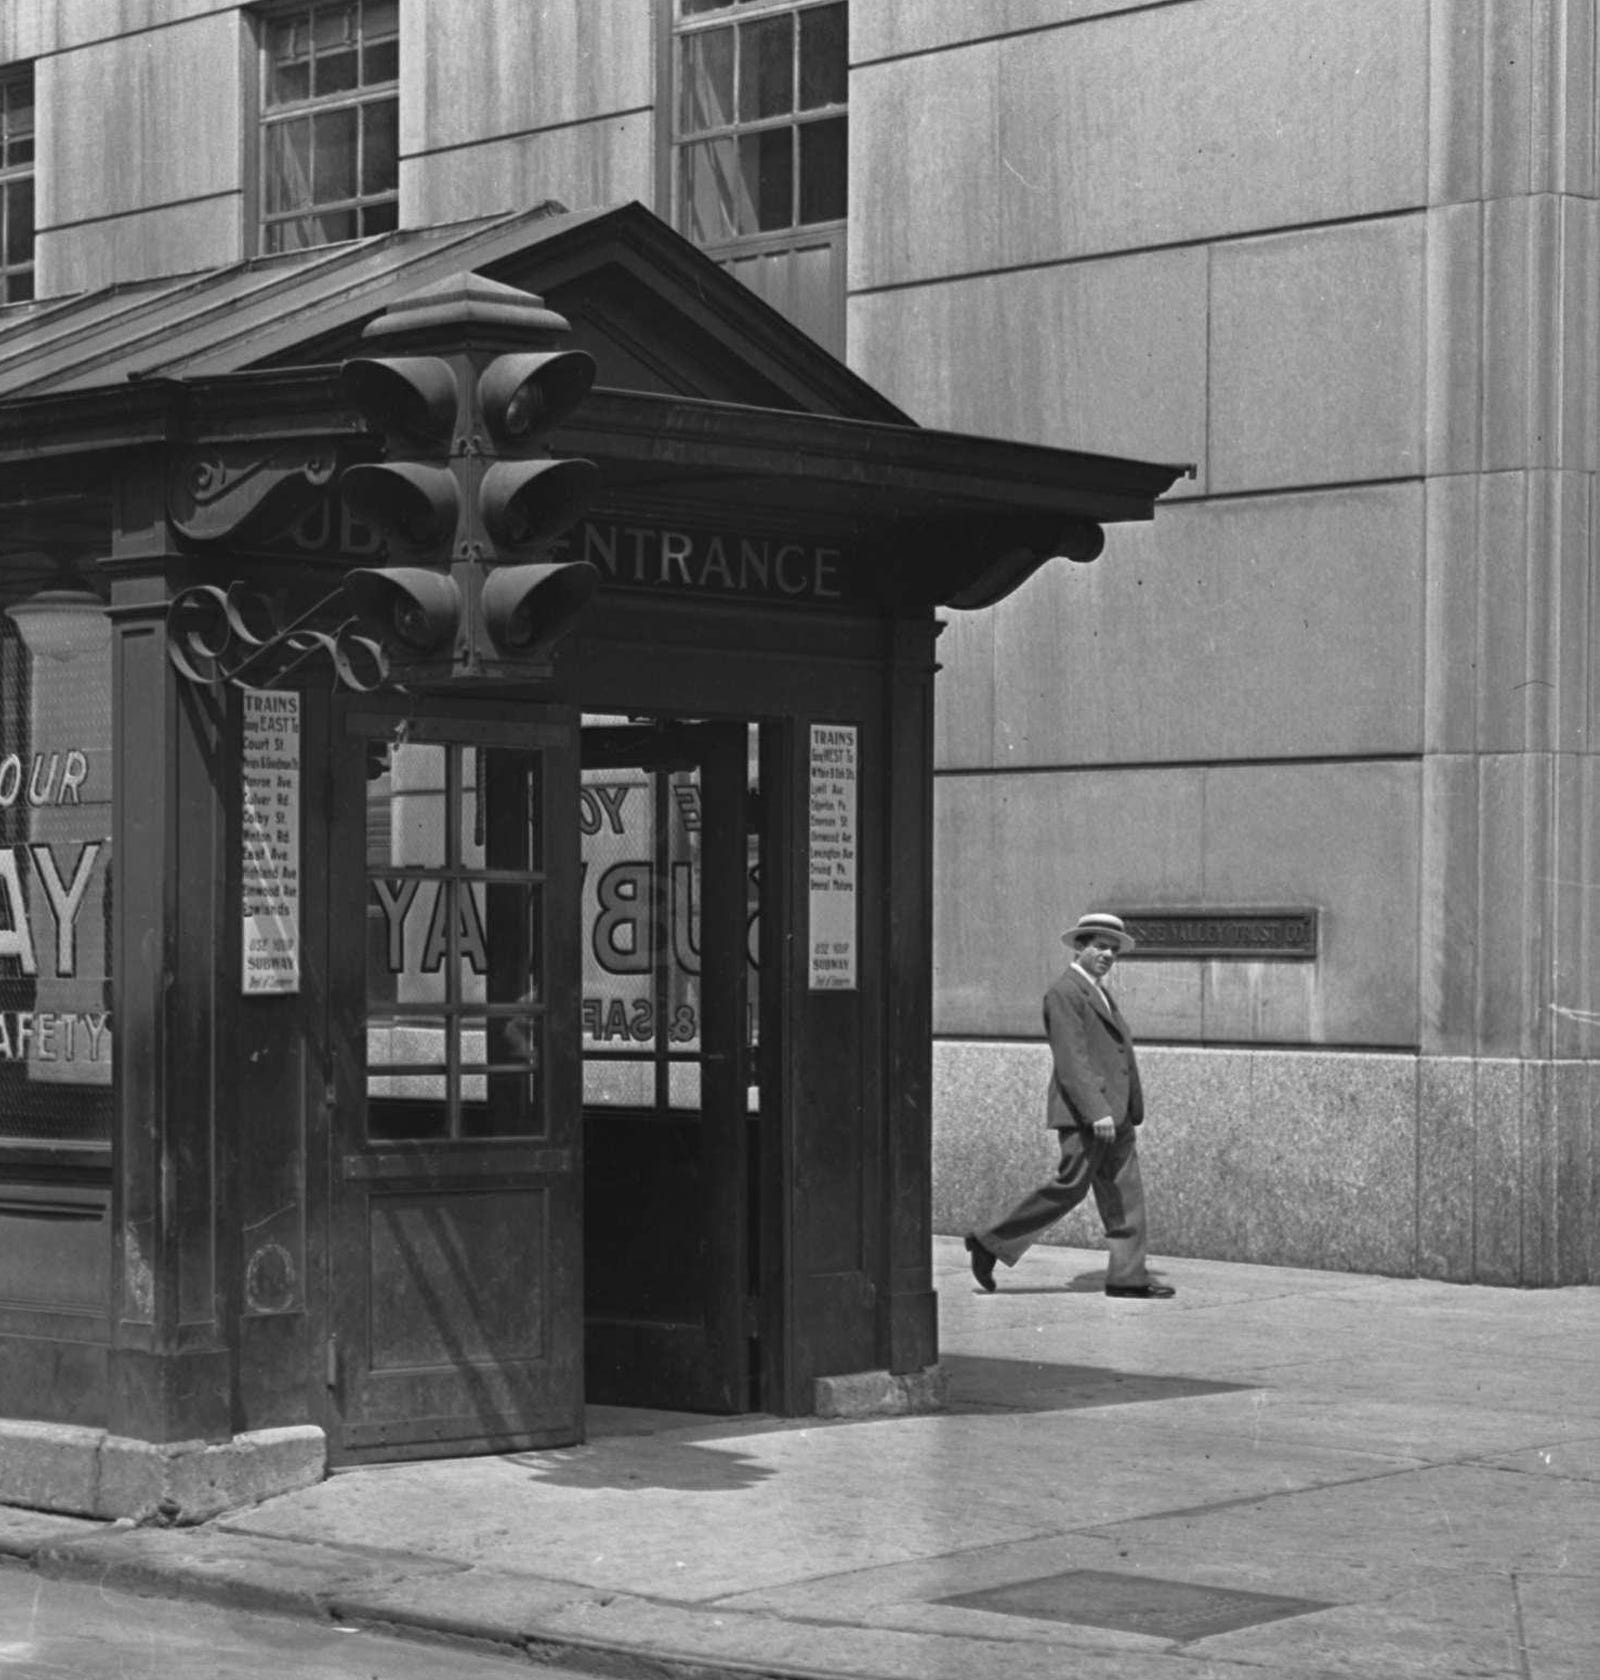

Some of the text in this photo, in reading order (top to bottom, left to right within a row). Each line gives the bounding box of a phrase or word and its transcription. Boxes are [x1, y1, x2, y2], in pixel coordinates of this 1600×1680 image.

[576, 519, 843, 600] NTRANCE
[244, 696, 298, 714] TRAINS
[260, 714, 289, 732] EAST
[813, 730, 854, 746] TRAINS
[247, 956, 294, 970] SUBWAY
[812, 958, 850, 971] SUBWAY
